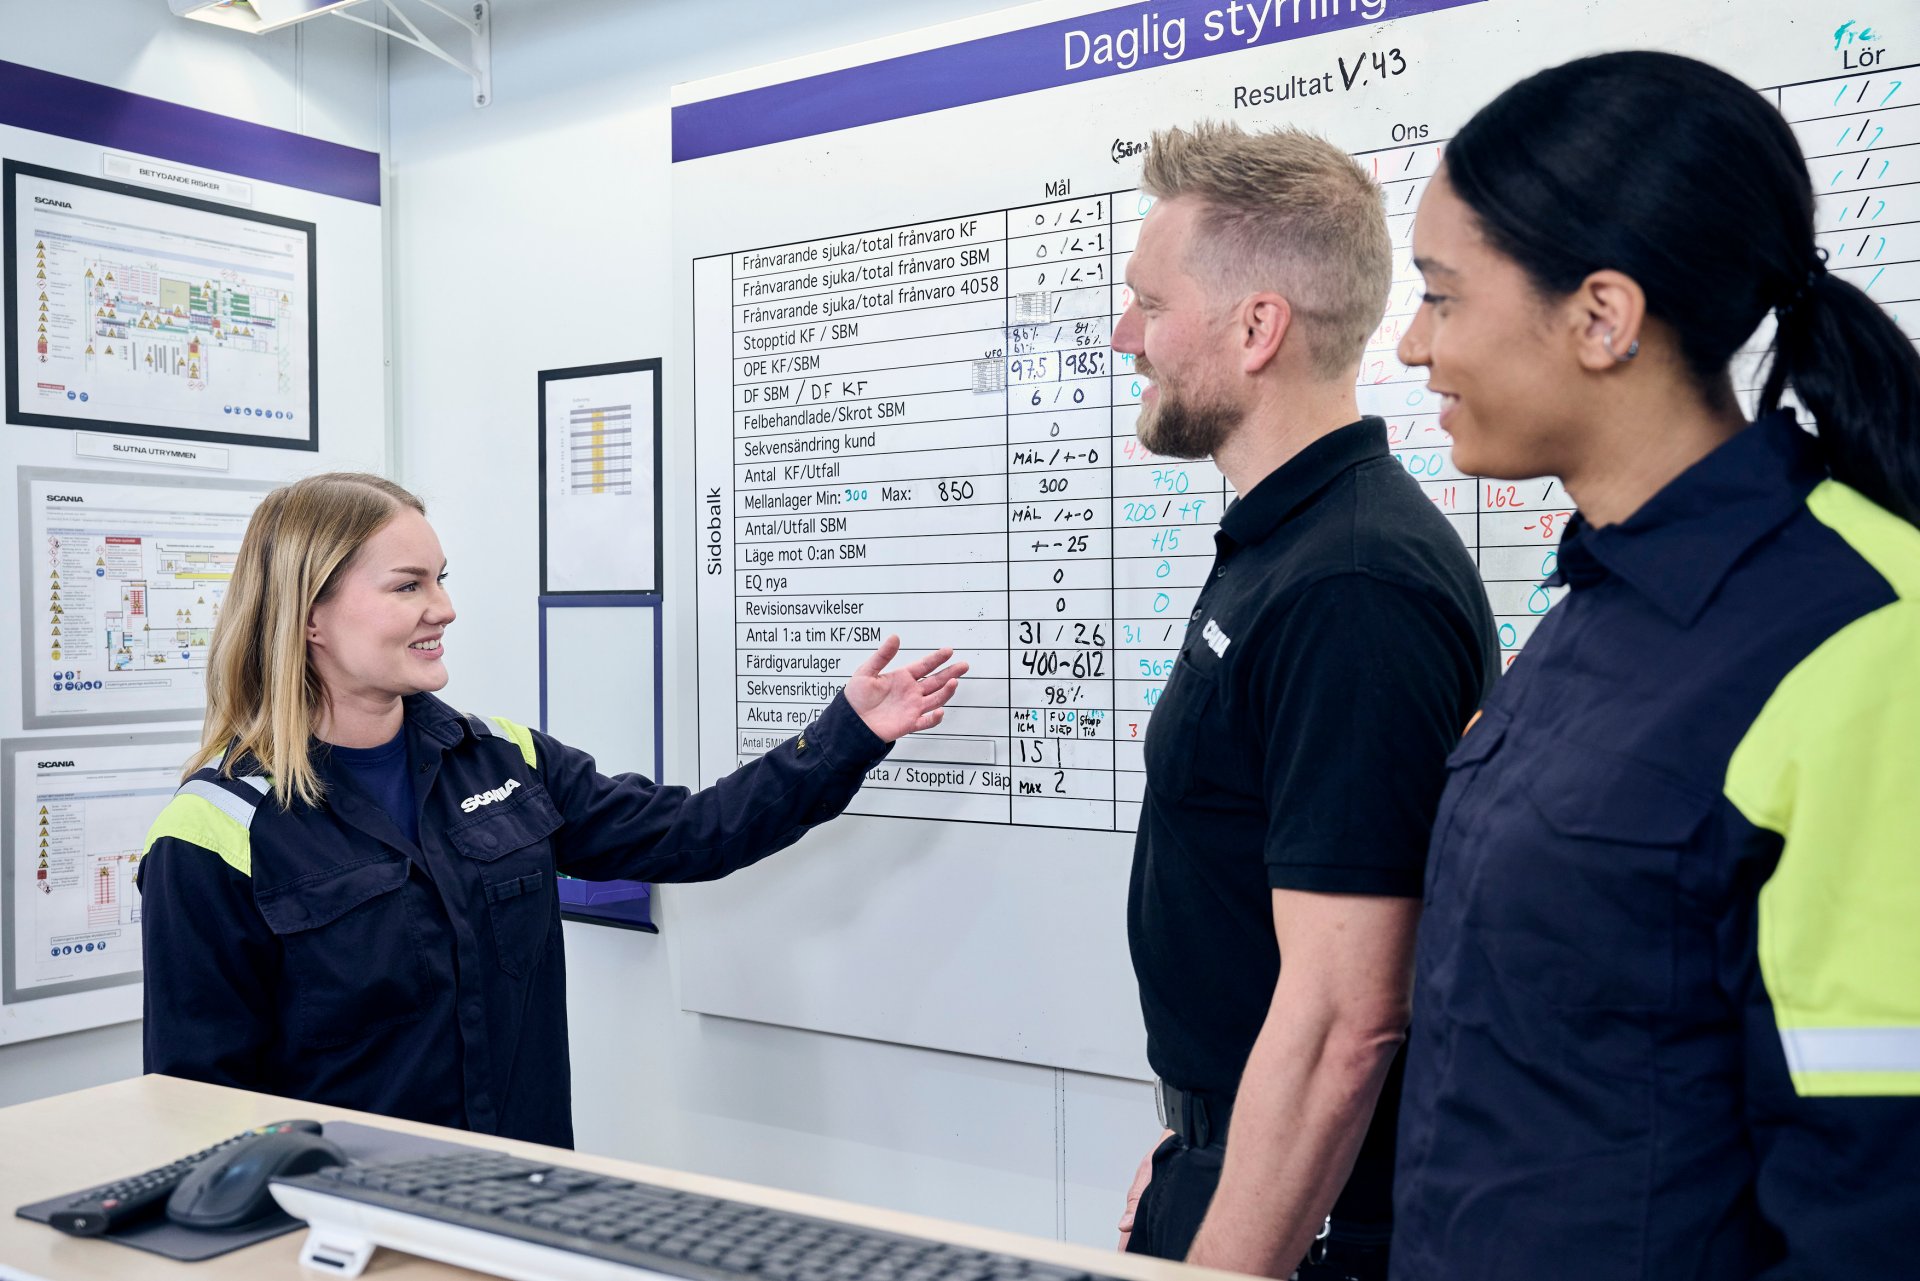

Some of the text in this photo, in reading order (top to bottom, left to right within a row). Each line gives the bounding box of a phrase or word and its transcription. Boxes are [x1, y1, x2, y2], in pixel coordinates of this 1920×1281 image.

[1064, 13, 1185, 73] Daglig
[1843, 47, 1885, 70] Lör
[1233, 71, 1333, 109] Resultat
[1391, 123, 1429, 142] Ons
[139, 168, 220, 191] BETYDANDE RISKER
[1045, 178, 1070, 198] Mål
[34, 196, 73, 209] SCANIA
[743, 221, 977, 271] Frånvarande sjuka/total frånvaro KF
[743, 248, 990, 297] Frånvarande sjuka/total frånvaro SBM
[743, 276, 999, 324] Frånvarande sjuka/total frånvaro 4058
[743, 323, 858, 351] Stopptid KF / SBM
[743, 355, 820, 377] OPE KF/SBM
[744, 388, 759, 403] DF
[763, 385, 789, 402] SBM
[812, 382, 833, 400] DF
[842, 380, 868, 396] KF
[1031, 390, 1042, 406] 6
[1073, 388, 1085, 404] 0
[744, 401, 906, 430] Felbehandlade/Skrot SBM
[1050, 422, 1060, 437] 0
[113, 444, 196, 460] SLUTNA UTRYMMEN
[744, 432, 876, 457] Sekvensändring kund
[745, 462, 840, 483] Antal KF/Utfall
[1151, 469, 1189, 493] 750
[745, 480, 974, 511] Mellanlager Min: 300 Max: 850
[1039, 477, 1068, 494] 300
[46, 494, 84, 503] SCANIA
[1124, 502, 1157, 521] 200
[707, 487, 722, 575] Sidobalk
[745, 517, 847, 536] Antal/Utfall SBM
[745, 546, 774, 566] Läge
[778, 545, 803, 562] mot
[839, 544, 866, 559] SBM
[1053, 568, 1064, 584] 0
[1156, 560, 1171, 578] 0
[745, 574, 787, 590] EQ nya
[745, 600, 864, 616] Revisionsavvikelser
[1056, 597, 1066, 613] 0
[1153, 592, 1170, 613] 0
[746, 626, 881, 643] Antal 1:a tim KF/SBM
[1019, 621, 1041, 644] 31
[1074, 622, 1106, 647] 26
[746, 654, 841, 672] Färdigvarulager
[747, 680, 847, 700] Sekvensriktighe
[747, 707, 783, 723] Akuta
[743, 737, 763, 748] Antal
[37, 760, 75, 769] SCANIA
[864, 765, 1011, 791] uta / Stopptid / Släp
[1054, 770, 1066, 794] 2
[460, 778, 522, 813] SCANIA
